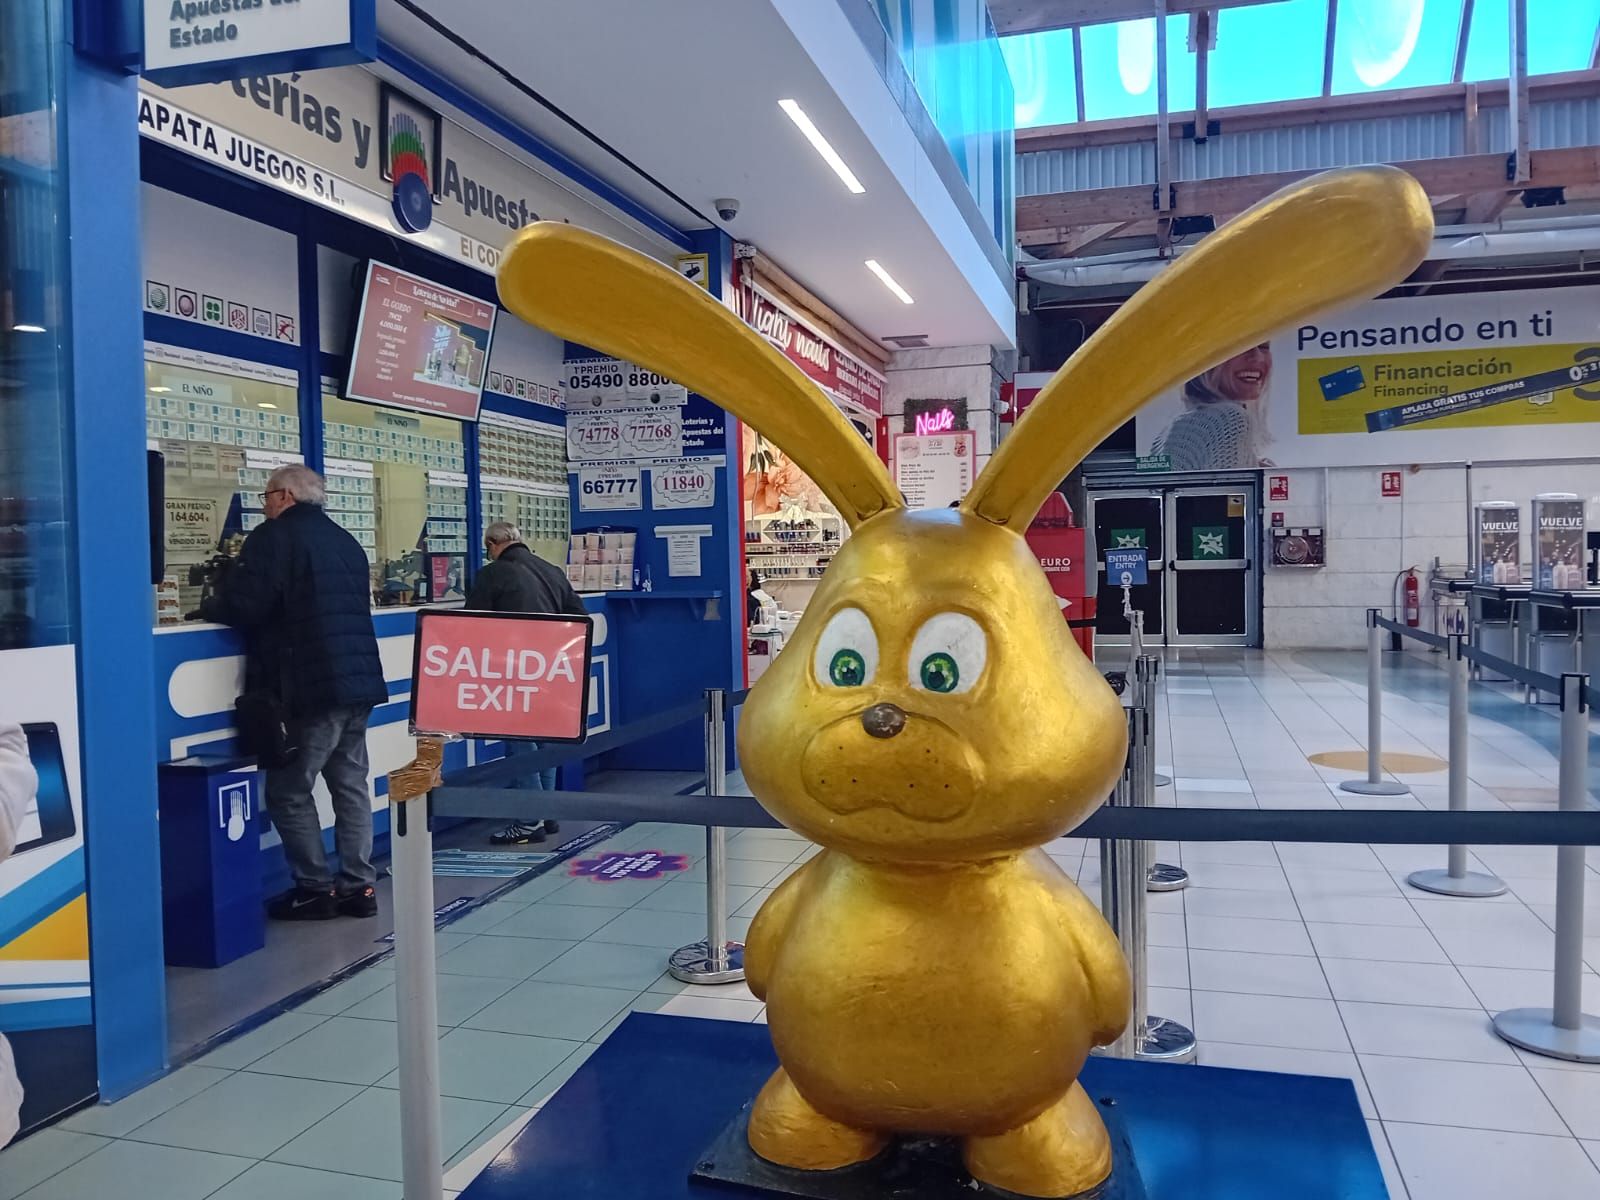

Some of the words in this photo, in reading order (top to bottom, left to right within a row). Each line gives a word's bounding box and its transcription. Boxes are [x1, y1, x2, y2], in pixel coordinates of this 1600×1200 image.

[170, 0, 264, 23] Apuestas
[170, 20, 238, 48] Estado
[213, 72, 343, 143] terías
[352, 117, 372, 169] y
[225, 137, 308, 190] JUEGOS
[313, 174, 345, 205] S.L.
[443, 158, 546, 230] Apuest
[1297, 317, 1464, 351] Pensando
[1476, 320, 1517, 340] en
[1529, 310, 1553, 337] ti
[580, 364, 619, 374] PREMIO
[1373, 357, 1513, 381] Financiación
[569, 373, 623, 389] 05490
[628, 372, 676, 387] 8800
[182, 383, 191, 393] EL
[193, 384, 213, 397] NIÑO
[1373, 382, 1449, 398] Financing
[1401, 402, 1433, 415] APLAZA
[1433, 393, 1467, 408] GRATIS
[1468, 390, 1484, 400] TUS
[1485, 381, 1525, 396] COMPRAS
[713, 426, 724, 435] del
[916, 408, 955, 437] Nails
[578, 427, 619, 441] 74778
[630, 424, 672, 439] 77768
[583, 478, 638, 494] 66777
[663, 475, 704, 490] 11840
[1482, 522, 1518, 530] VUELVE
[1540, 517, 1583, 526] VUELVE
[1040, 557, 1071, 566] EURO
[1108, 554, 1144, 562] ENTRADA
[424, 645, 576, 682] SALIDA
[457, 683, 539, 713] EXIT
